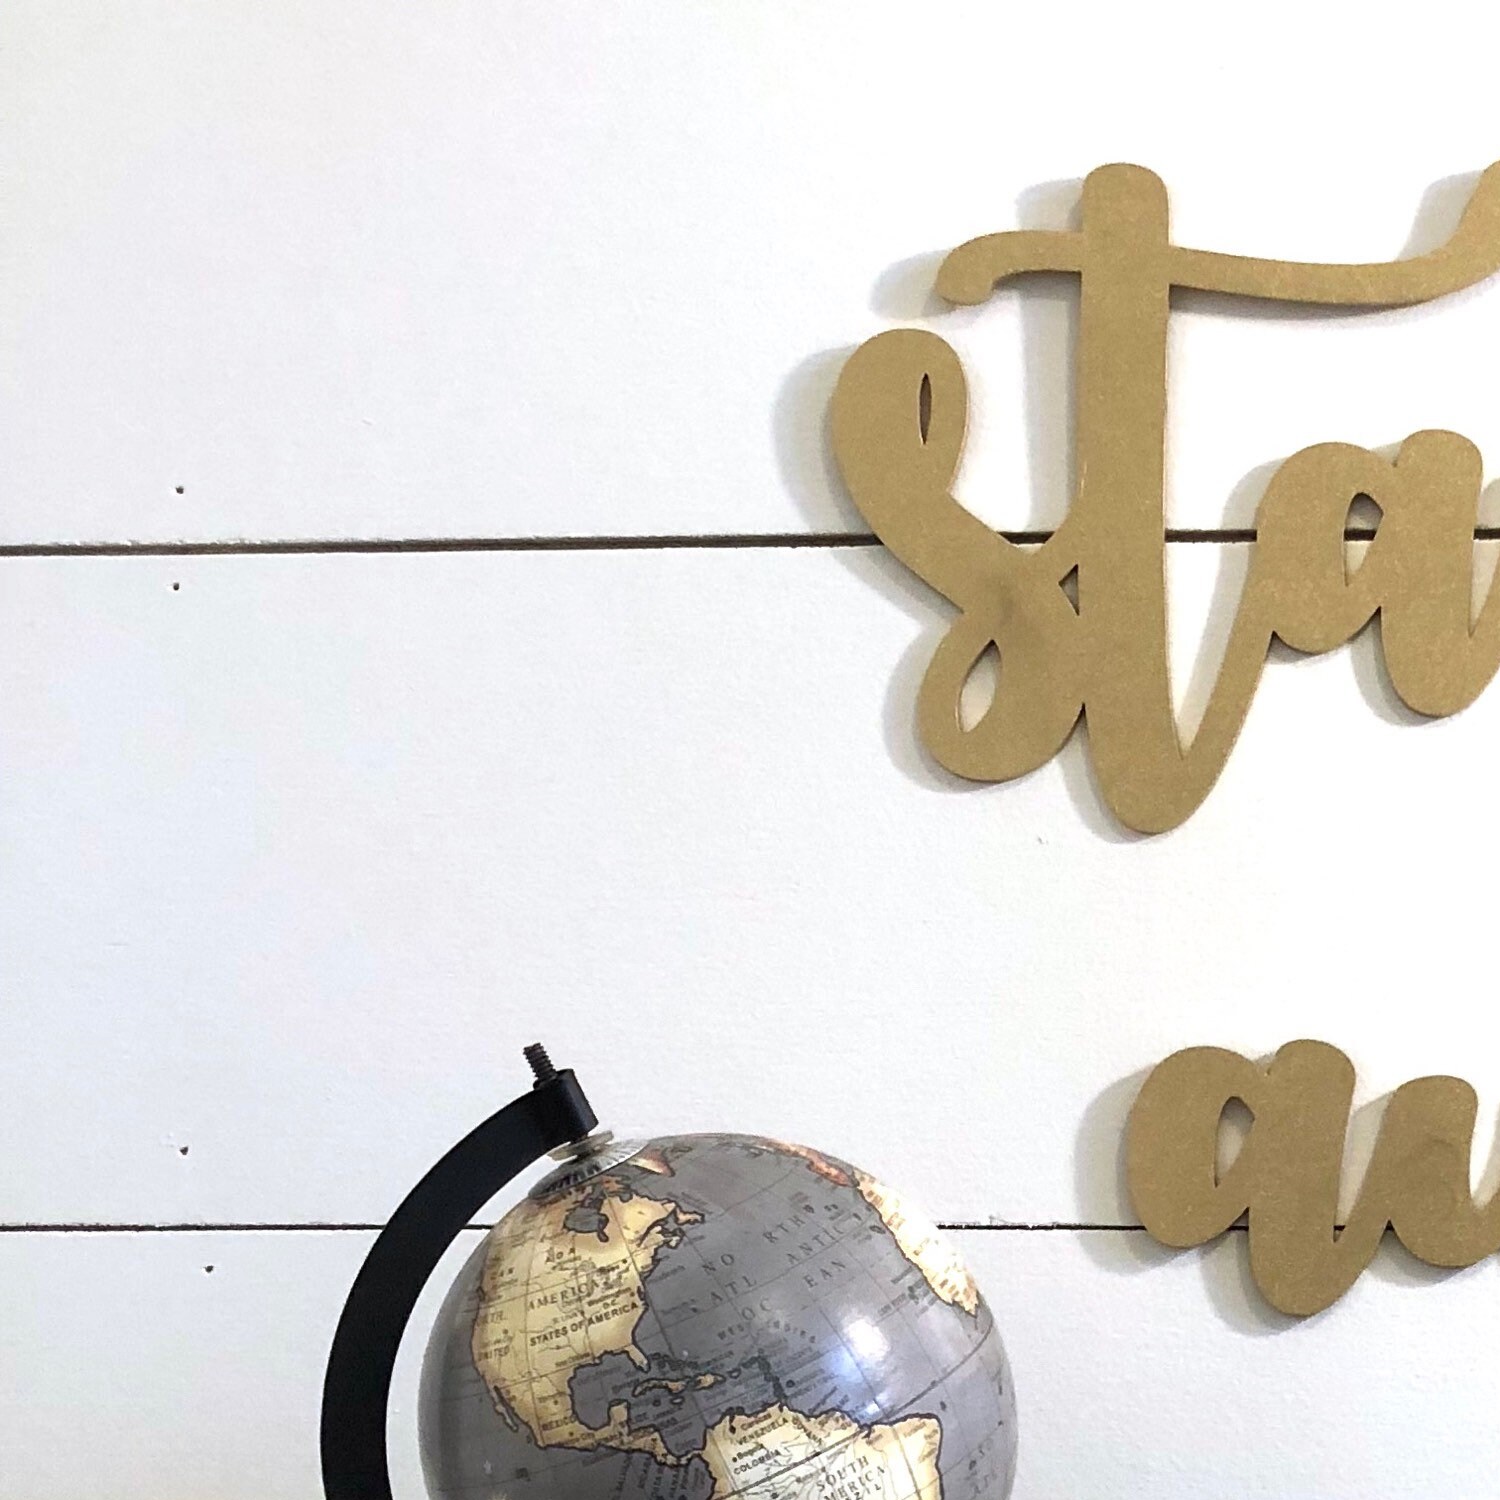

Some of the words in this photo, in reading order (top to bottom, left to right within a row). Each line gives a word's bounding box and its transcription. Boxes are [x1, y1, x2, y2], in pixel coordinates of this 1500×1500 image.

[529, 1324, 569, 1347] STATES
[570, 1319, 585, 1333] OF
[587, 1302, 639, 1326] AMERICA
[736, 1417, 789, 1446] VENEZUELA
[733, 1449, 781, 1475] COLOMBIA
[816, 1455, 870, 1492] SOUTH
